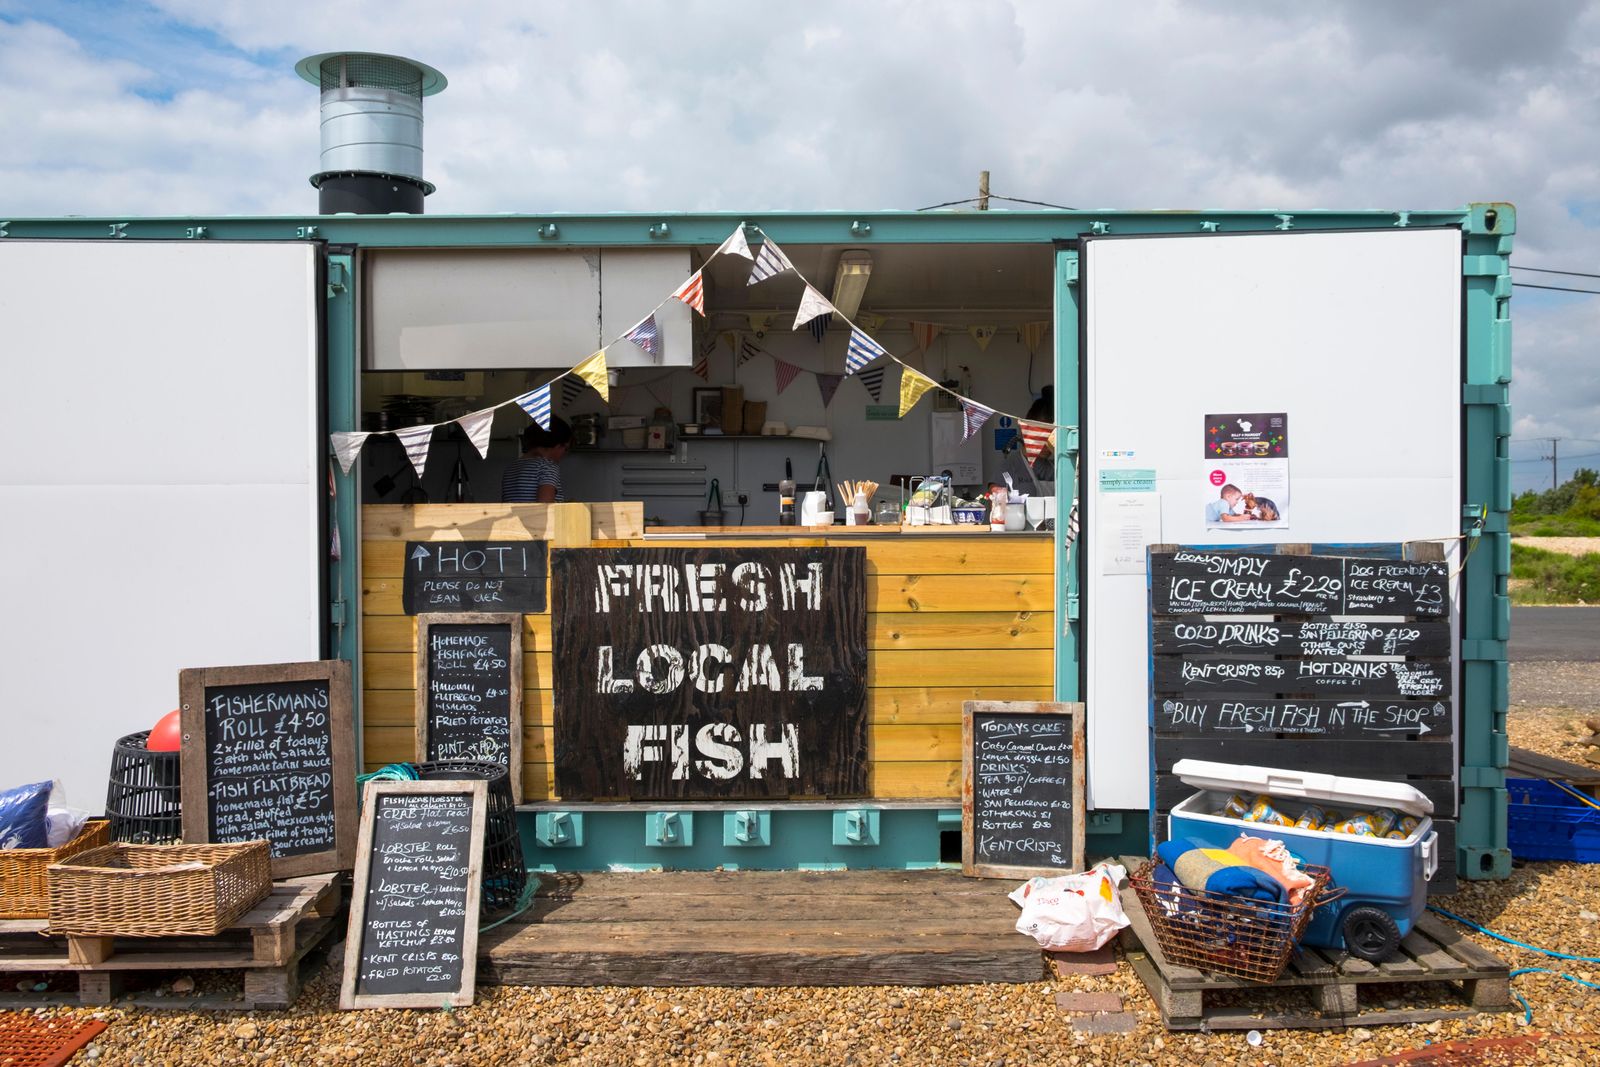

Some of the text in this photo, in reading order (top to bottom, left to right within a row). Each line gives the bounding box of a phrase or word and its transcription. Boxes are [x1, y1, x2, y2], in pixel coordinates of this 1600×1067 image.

[1208, 556, 1271, 576] SIMPLY
[1349, 565, 1430, 578] DOG FRIENDLY
[424, 581, 460, 591] PLEASE
[485, 580, 504, 591] NOT
[595, 562, 824, 613] FRESH
[1170, 576, 1206, 602] ICE
[1211, 579, 1272, 602] CREAM
[1351, 578, 1443, 604] ICE CREAM £3
[430, 592, 503, 603] LEAN OVER
[1175, 624, 1280, 646] COLD DRINKS
[1298, 630, 1318, 639] SAN
[1320, 628, 1383, 640] PELLEGRINO
[432, 635, 488, 650] HOMEMADE
[1301, 641, 1365, 650] OTHER CANS
[435, 660, 466, 670] ROLL
[597, 643, 824, 694] LOCAL
[1182, 662, 1285, 680] KENT CRISPS 85p
[1299, 661, 1387, 678] HOT DRINKS
[436, 715, 466, 728] FRIED
[1172, 702, 1429, 728] BUY FRESH FISH IN THE SHOP
[220, 717, 267, 741] ROLL
[234, 741, 265, 754] fillet
[269, 736, 282, 751] of
[438, 741, 464, 755] PINT
[623, 722, 800, 780] FISH
[254, 751, 277, 760] with
[281, 748, 314, 758] salad
[982, 753, 1011, 761] Lemon
[303, 757, 331, 767] sauce
[982, 776, 1001, 785] TEA
[214, 782, 247, 799] FISH
[983, 789, 1012, 798] WATER
[216, 794, 294, 813] homemade flat
[255, 808, 292, 824] stuffed
[384, 808, 417, 820] CRAB
[1015, 810, 1037, 818] CANS
[216, 823, 238, 835] with
[316, 811, 334, 826] style
[265, 829, 287, 841] fillet
[291, 827, 300, 837] of
[274, 841, 293, 849] sour
[295, 837, 323, 847] cream
[380, 842, 432, 854] LOBSTER
[979, 835, 1062, 856] KENT CRISPS
[378, 878, 433, 894] LOBSTER
[372, 920, 412, 929] BOTTLES
[377, 929, 430, 940] HASTINGS
[379, 938, 426, 948] KETCHUP
[370, 954, 398, 964] KENT
[401, 952, 437, 961] CRISPS
[368, 966, 442, 980] FRIED POTATOES
